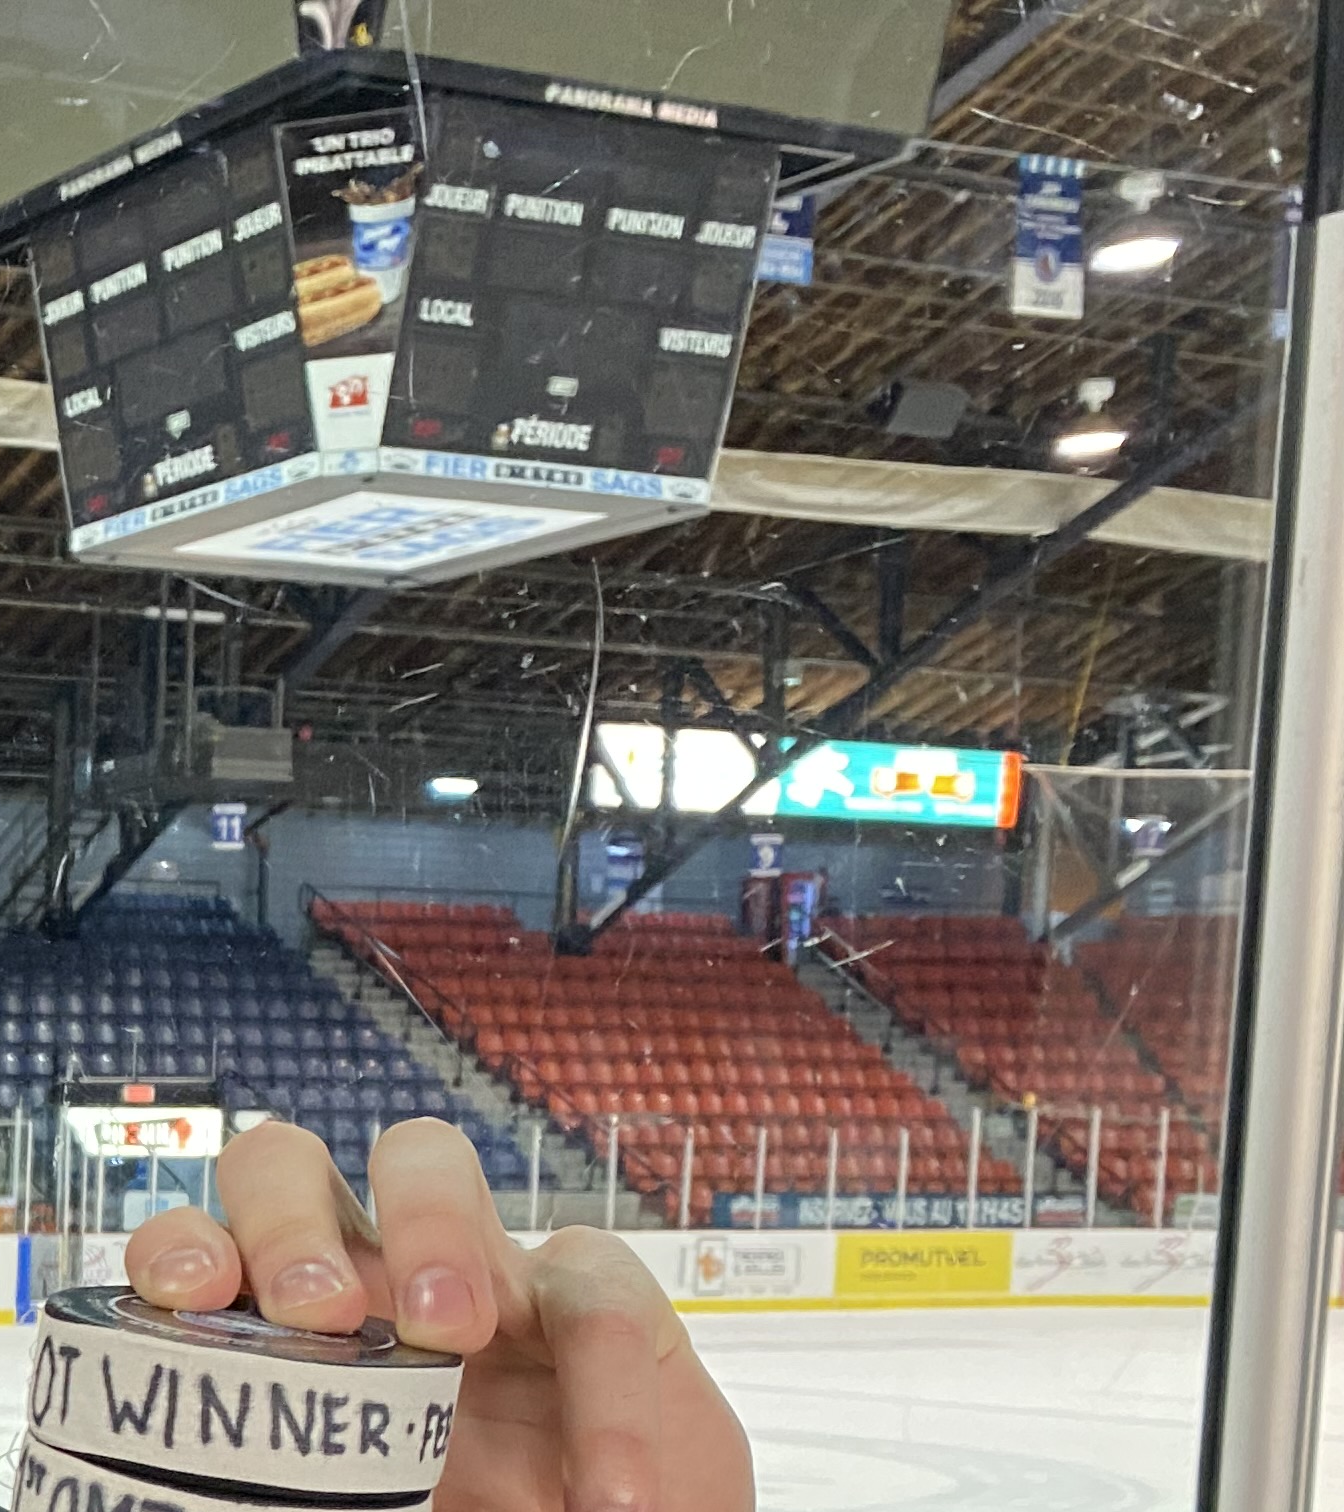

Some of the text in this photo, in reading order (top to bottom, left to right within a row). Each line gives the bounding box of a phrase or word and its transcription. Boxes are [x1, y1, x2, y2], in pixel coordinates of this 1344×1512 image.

[418, 297, 474, 327] LOCAL
[224, 467, 283, 499] SAGS
[424, 455, 487, 480] FIER
[590, 471, 663, 498] SAGS
[217, 815, 242, 841] 11
[30, 1335, 81, 1428] OT
[102, 1353, 392, 1458] WINNER
